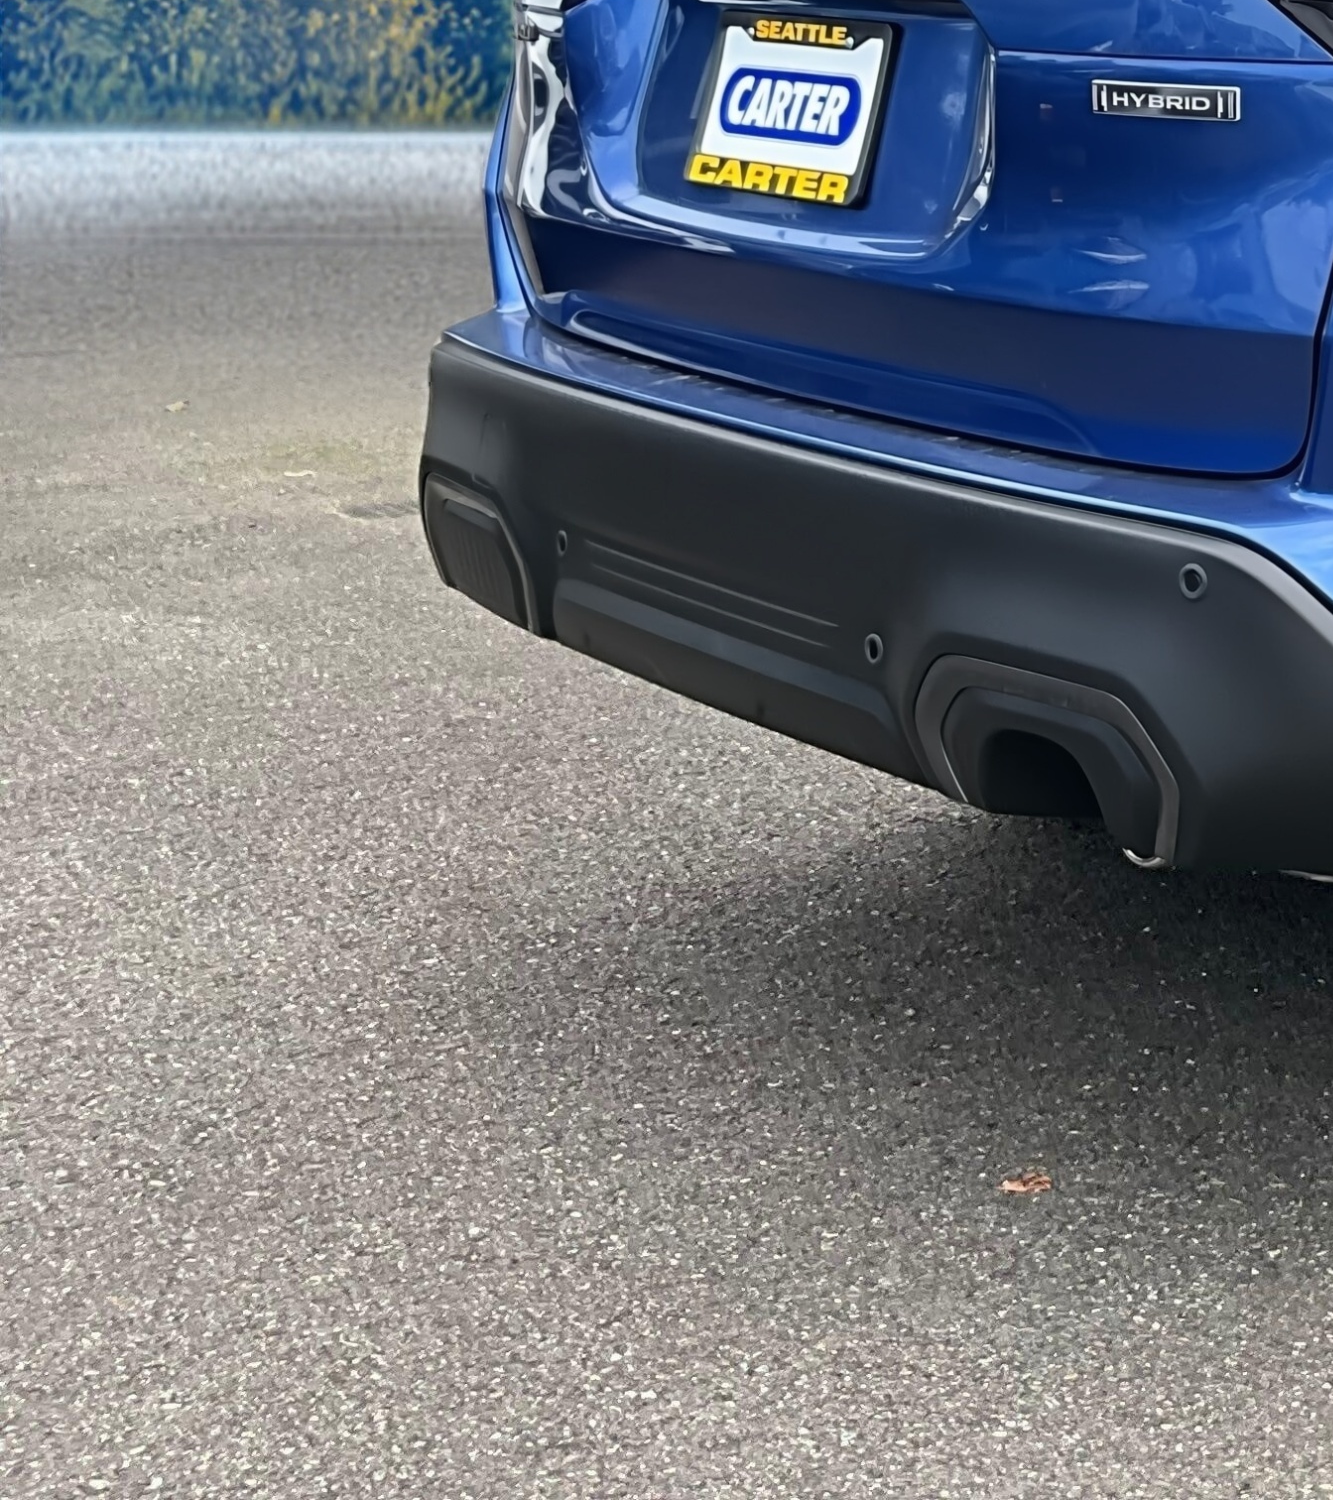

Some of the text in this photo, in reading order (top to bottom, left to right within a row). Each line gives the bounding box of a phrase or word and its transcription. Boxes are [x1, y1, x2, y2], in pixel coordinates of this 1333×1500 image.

[755, 19, 848, 46] SEATTLE
[726, 74, 851, 136] CARTER
[1111, 91, 1211, 111] HYBRID
[688, 153, 850, 203] CARTER
